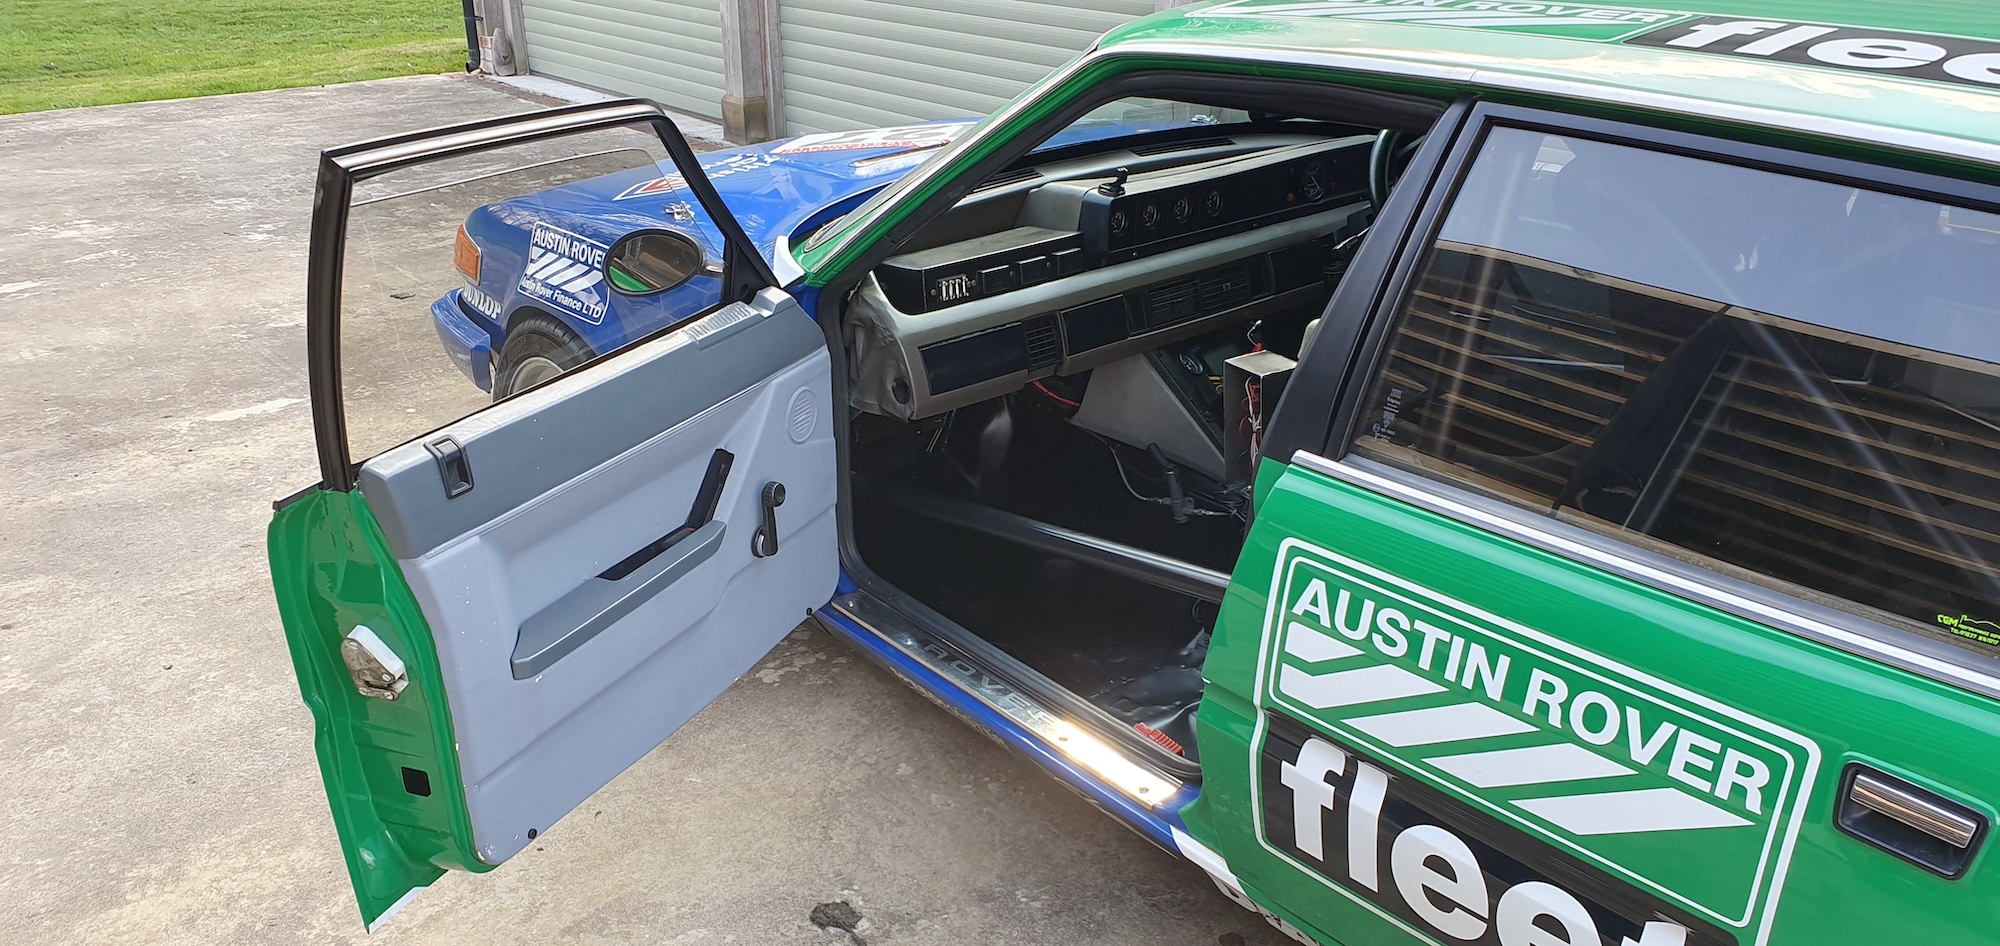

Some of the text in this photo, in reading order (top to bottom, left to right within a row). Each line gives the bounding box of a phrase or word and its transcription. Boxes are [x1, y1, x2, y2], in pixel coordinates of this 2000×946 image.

[533, 228, 571, 256] AUSTIN
[463, 282, 502, 320] DUNLOP
[521, 277, 602, 318] Austin Rover Finance LTD
[1937, 614, 1959, 627] CGM
[1291, 577, 1771, 815] AUSTIN ROVER
[1280, 737, 1688, 946] flee
